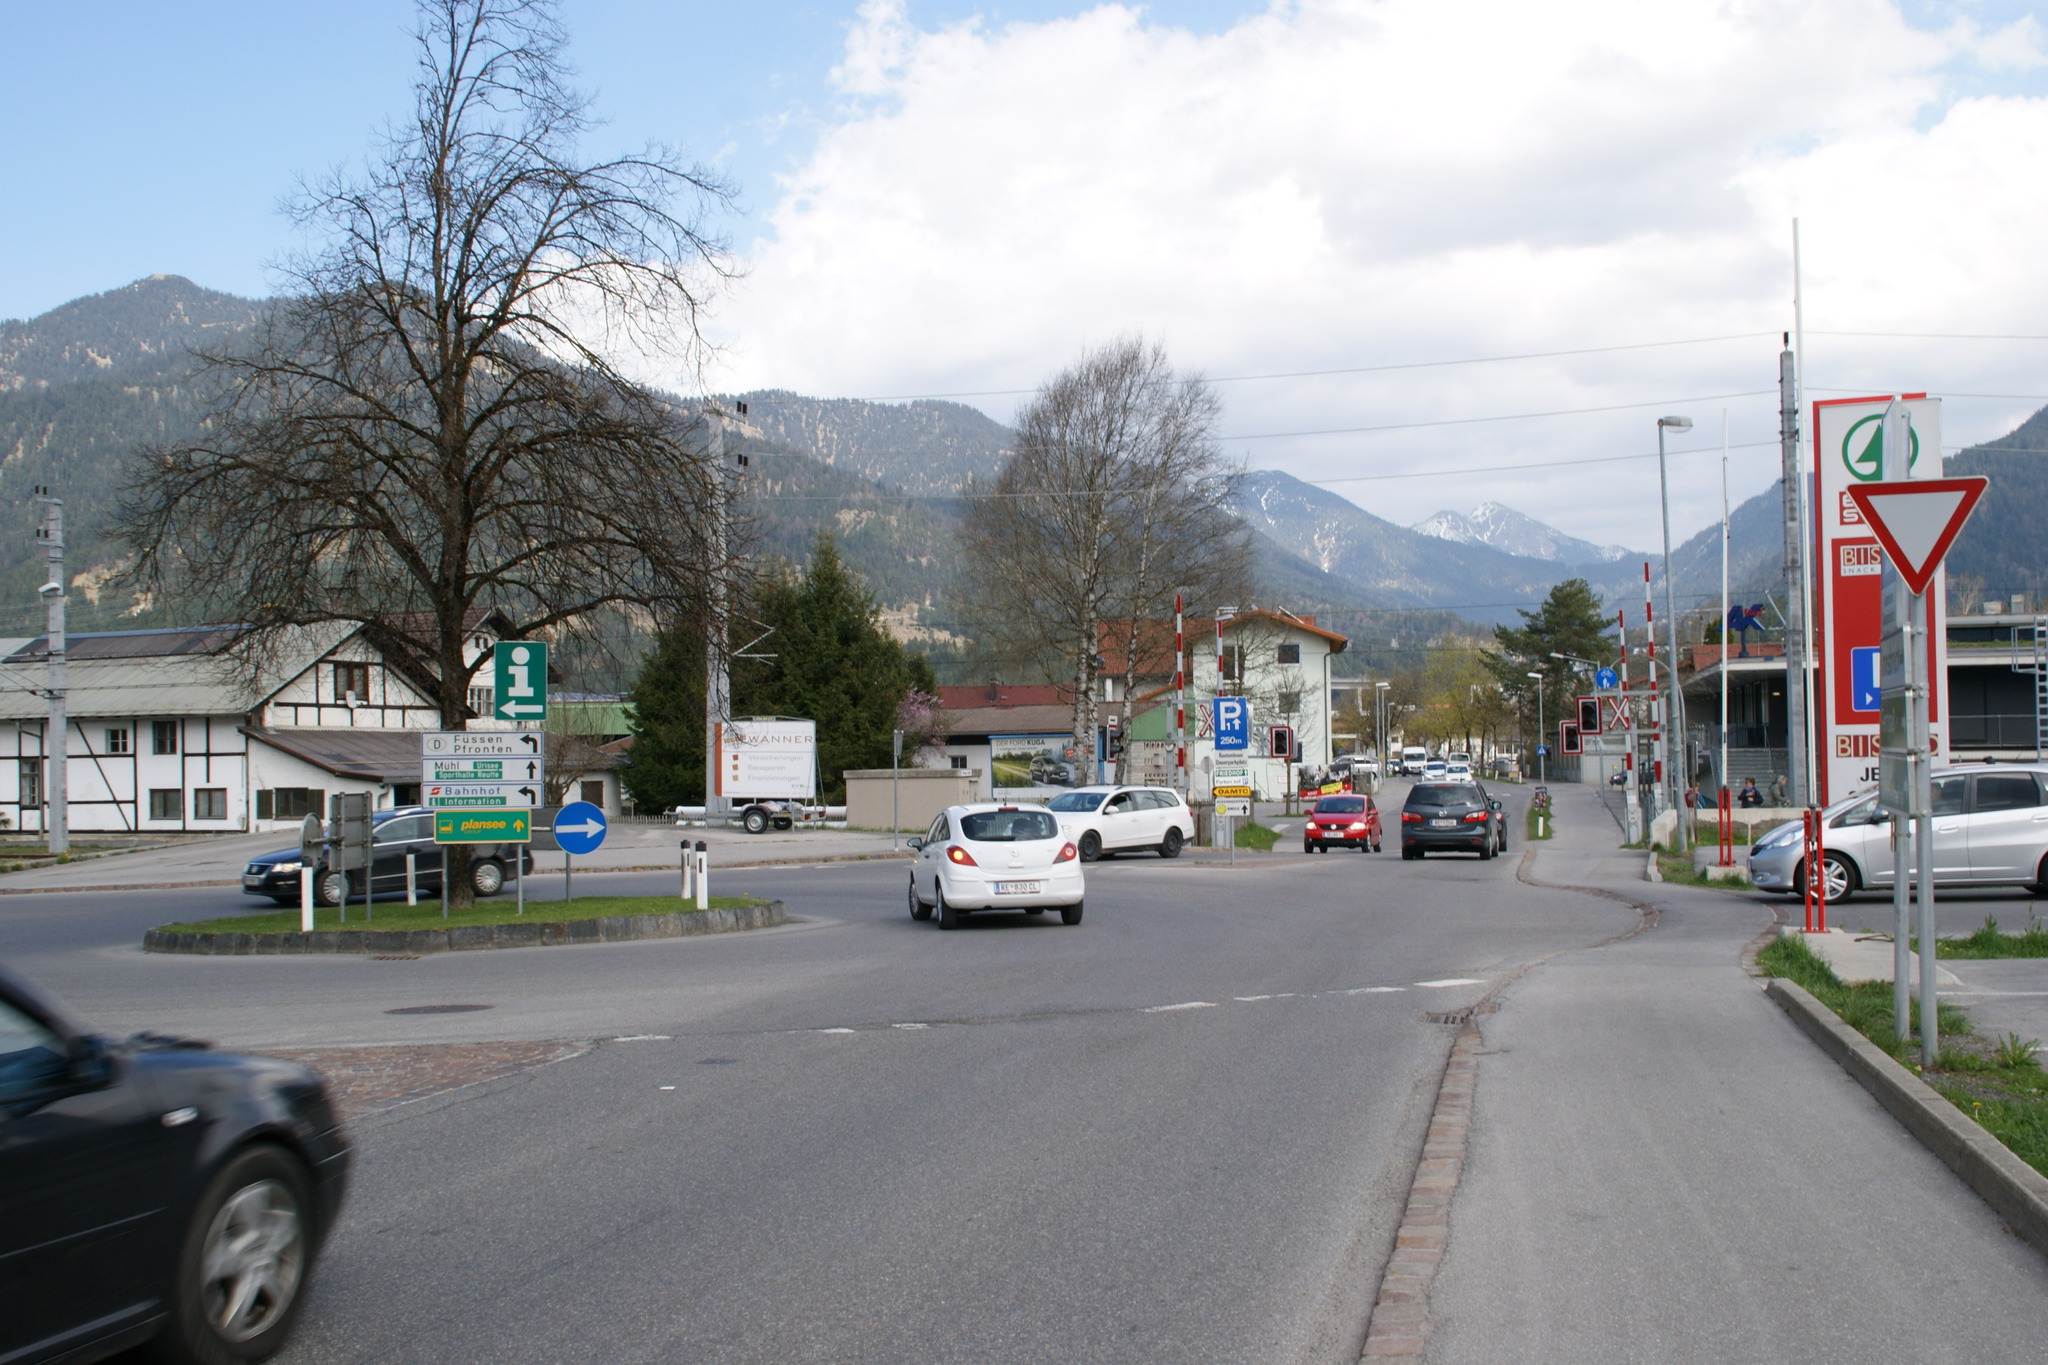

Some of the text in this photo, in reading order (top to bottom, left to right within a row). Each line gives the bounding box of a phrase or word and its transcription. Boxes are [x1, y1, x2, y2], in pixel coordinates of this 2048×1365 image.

[1220, 701, 1241, 731] P
[434, 739, 441, 749] D
[454, 735, 503, 744] Füssen
[748, 735, 813, 744] WANNER
[1220, 736, 1242, 744] 250m
[454, 745, 512, 753] Pfronten
[748, 754, 804, 762] Versicherungen
[435, 761, 460, 770] Mühl
[476, 761, 499, 769] Urisee
[439, 771, 475, 780] Sporthalle
[445, 787, 500, 796] Bahnhof
[445, 797, 501, 805] Information
[461, 819, 507, 831] plansee
